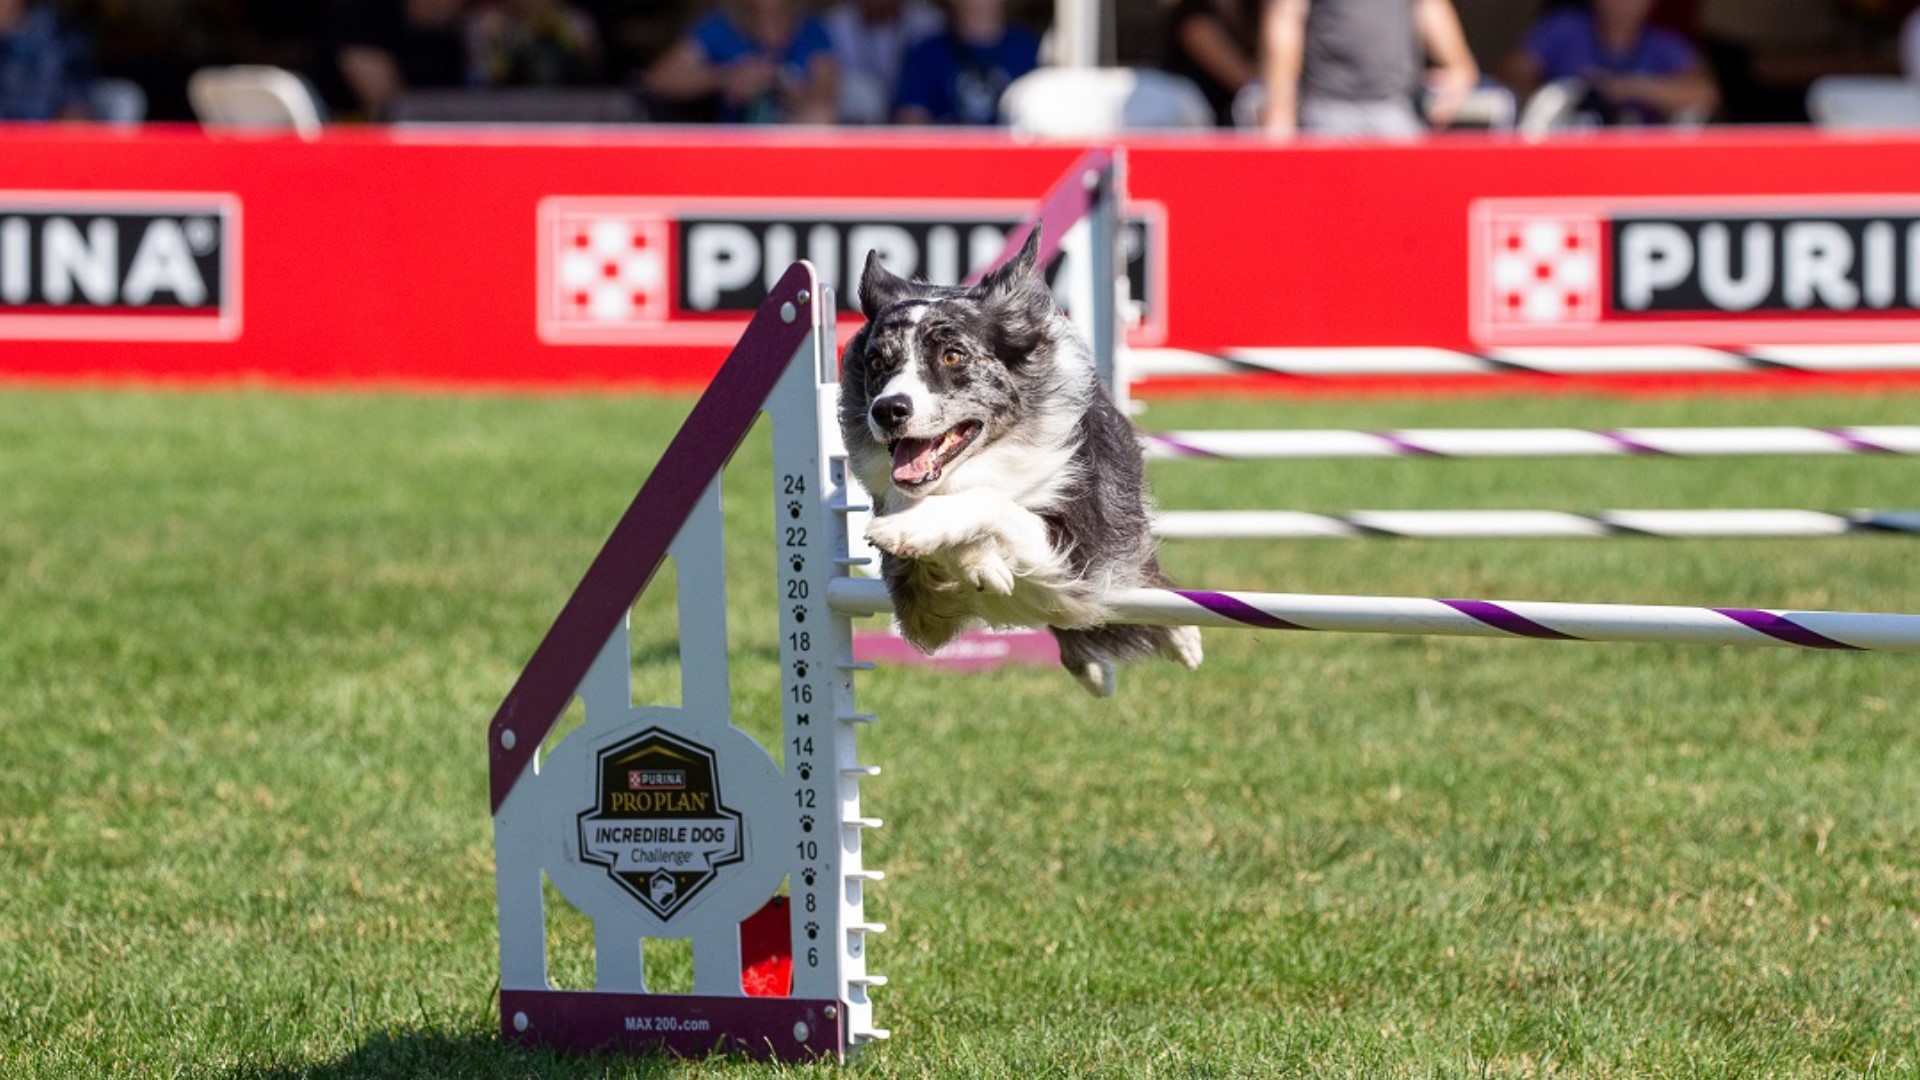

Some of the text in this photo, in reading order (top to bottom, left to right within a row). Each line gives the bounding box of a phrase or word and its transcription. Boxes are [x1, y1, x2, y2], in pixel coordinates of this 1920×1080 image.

[1619, 219, 1920, 311] PURI
[784, 474, 806, 494] 24
[786, 527, 807, 547] 22
[787, 579, 809, 599] 20
[789, 632, 810, 652] 18
[791, 684, 812, 704] 16
[792, 736, 814, 756] 14
[641, 774, 682, 785] PURINA
[611, 792, 653, 812] PRO
[794, 788, 816, 808] 12
[595, 827, 725, 843] INCREDIBLE DOG
[631, 848, 691, 866] Challenge
[796, 841, 818, 861] 10
[805, 893, 816, 913] 8
[807, 947, 818, 967] 6
[625, 1016, 710, 1031] MAX 200.com
